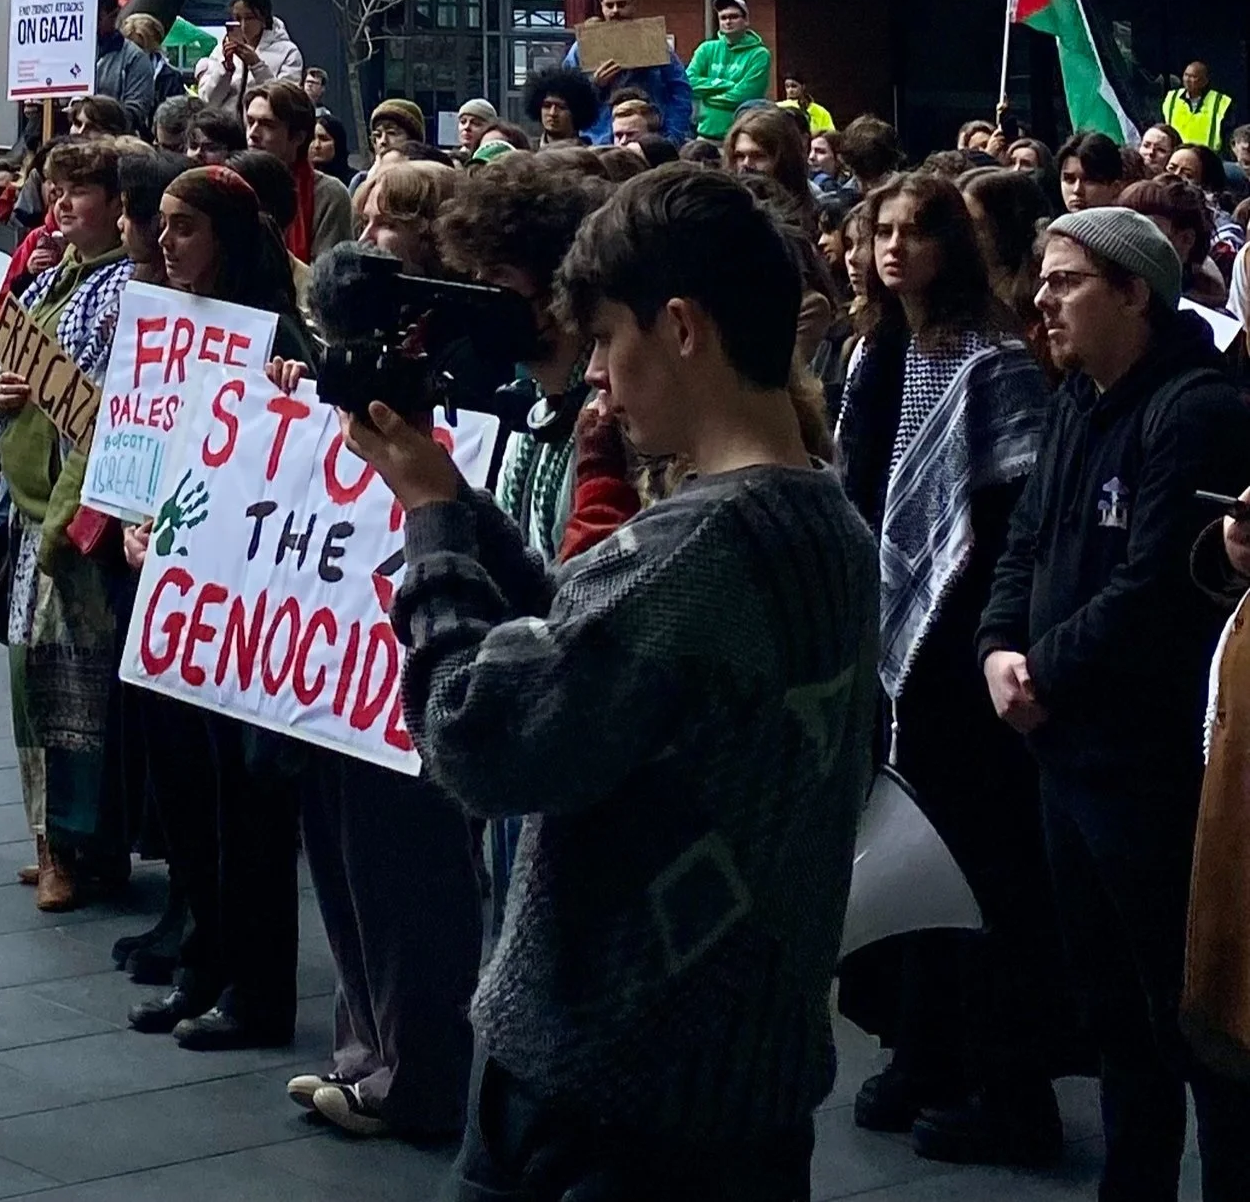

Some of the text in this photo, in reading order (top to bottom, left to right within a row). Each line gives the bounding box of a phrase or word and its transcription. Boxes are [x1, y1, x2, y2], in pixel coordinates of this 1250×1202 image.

[55, 1, 84, 13] ATTACKS
[18, 14, 84, 45] ON GAZA!
[134, 317, 252, 389] FREE
[103, 431, 155, 452] BOYCOTT
[246, 500, 356, 583] THE
